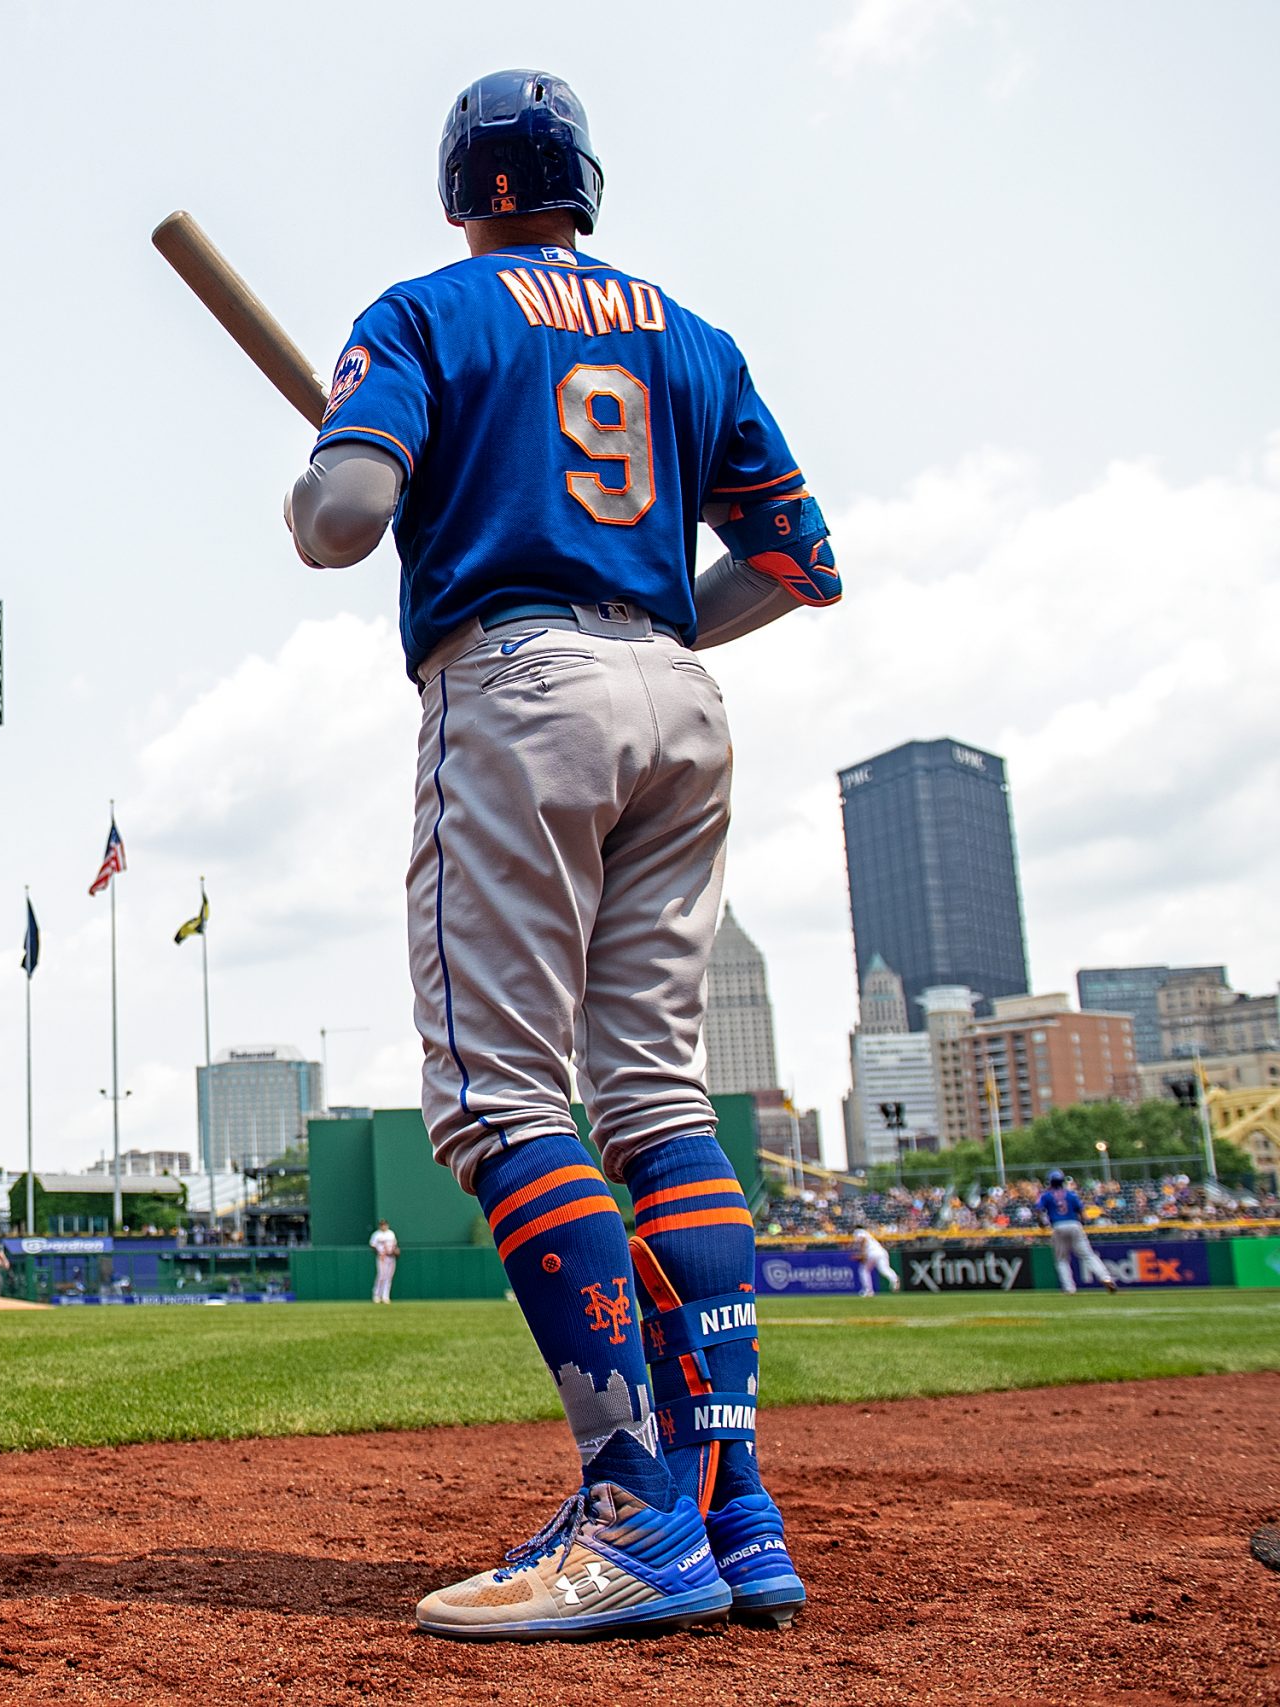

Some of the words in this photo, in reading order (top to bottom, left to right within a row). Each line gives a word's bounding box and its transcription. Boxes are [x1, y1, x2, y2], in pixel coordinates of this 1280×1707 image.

[495, 174, 508, 194] 9
[497, 267, 666, 337] NIMMO
[556, 363, 657, 526] 9
[773, 513, 792, 536] 9
[770, 1263, 854, 1283] Guardian
[908, 1250, 1023, 1293] xfinity
[676, 1542, 711, 1573] UNDER
[718, 1543, 762, 1569] UNDER
